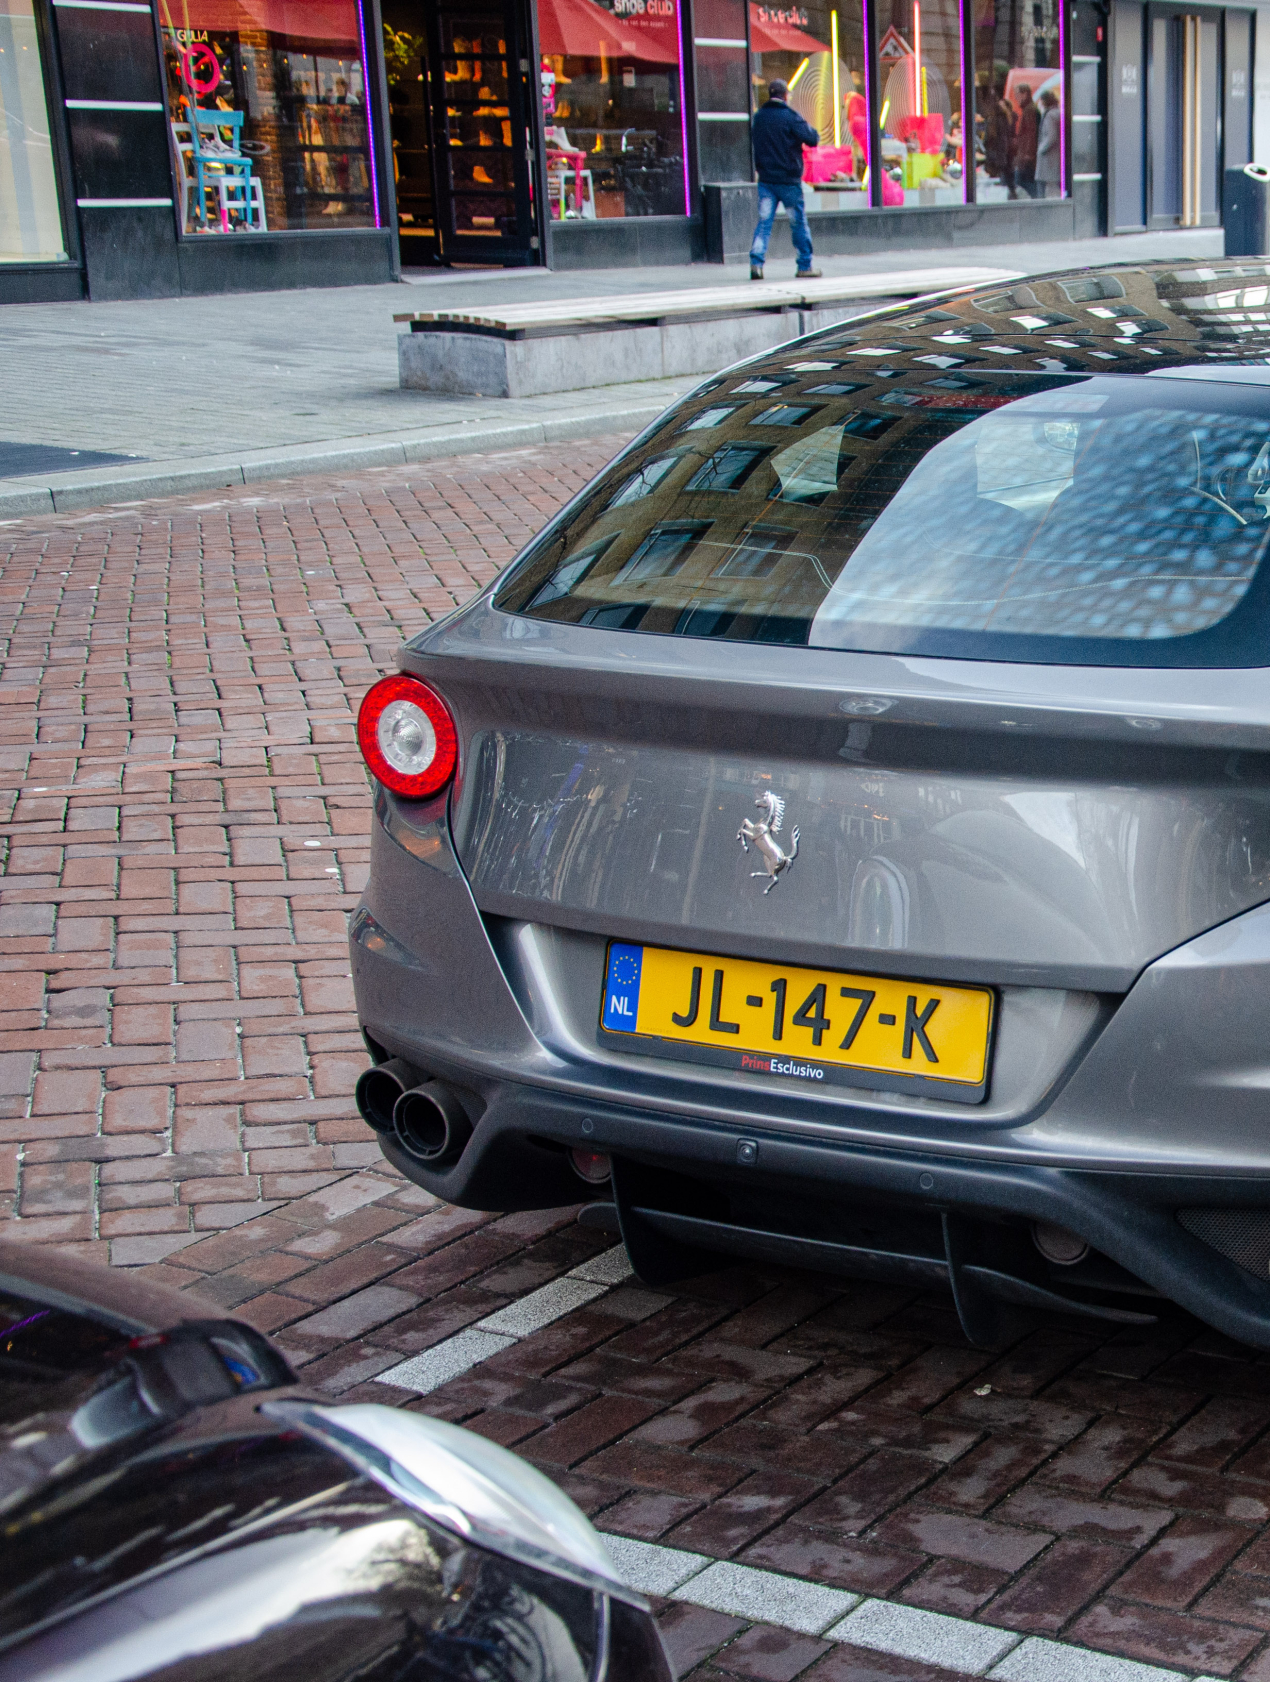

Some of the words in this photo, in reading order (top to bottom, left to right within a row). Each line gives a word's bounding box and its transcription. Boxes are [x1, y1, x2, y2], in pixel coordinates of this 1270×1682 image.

[647, 0, 674, 15] club
[611, 994, 632, 1017] NL
[671, 966, 941, 1063] JL-147-K
